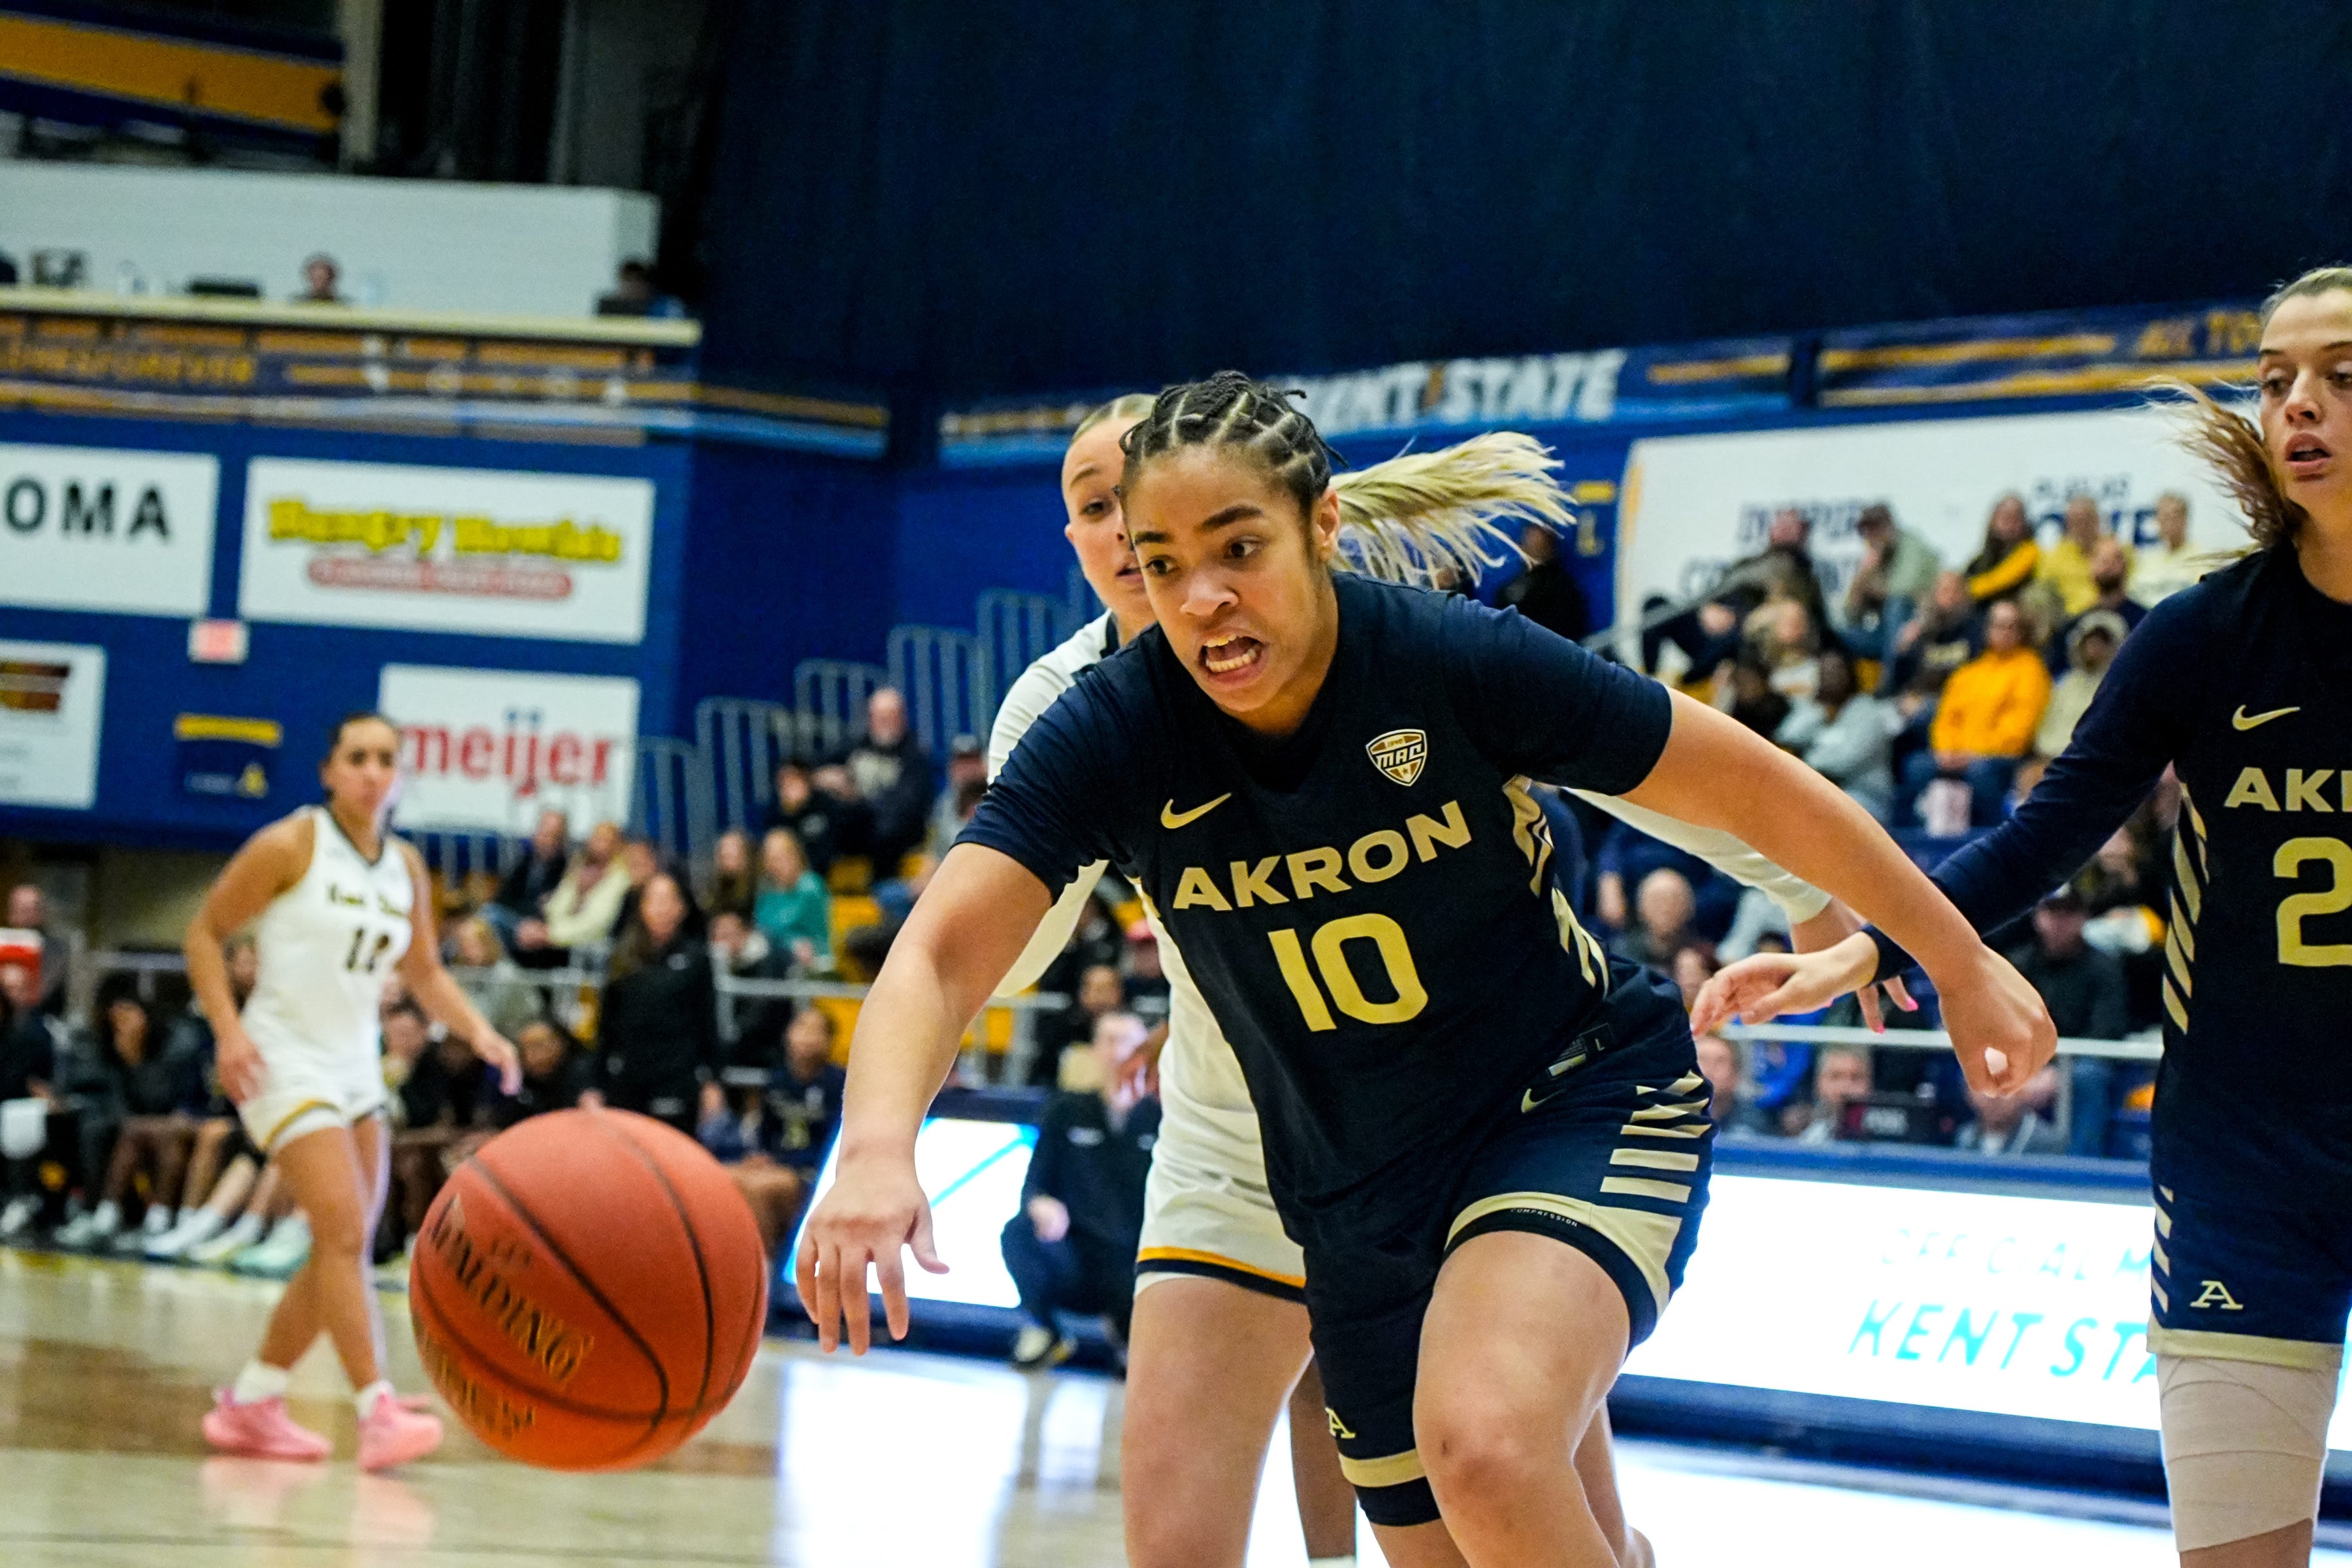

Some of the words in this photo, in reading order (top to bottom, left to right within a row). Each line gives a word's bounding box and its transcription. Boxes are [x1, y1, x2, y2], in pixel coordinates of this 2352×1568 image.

[1439, 348, 1628, 423] STATE
[397, 708, 613, 797] meijer
[1375, 743, 1425, 770] MAC
[1173, 800, 1472, 911] AKRON
[1267, 913, 1429, 1032] 10
[2189, 1280, 2244, 1310] A
[1847, 1298, 2046, 1371] KENT
[1325, 1407, 1356, 1439] A
